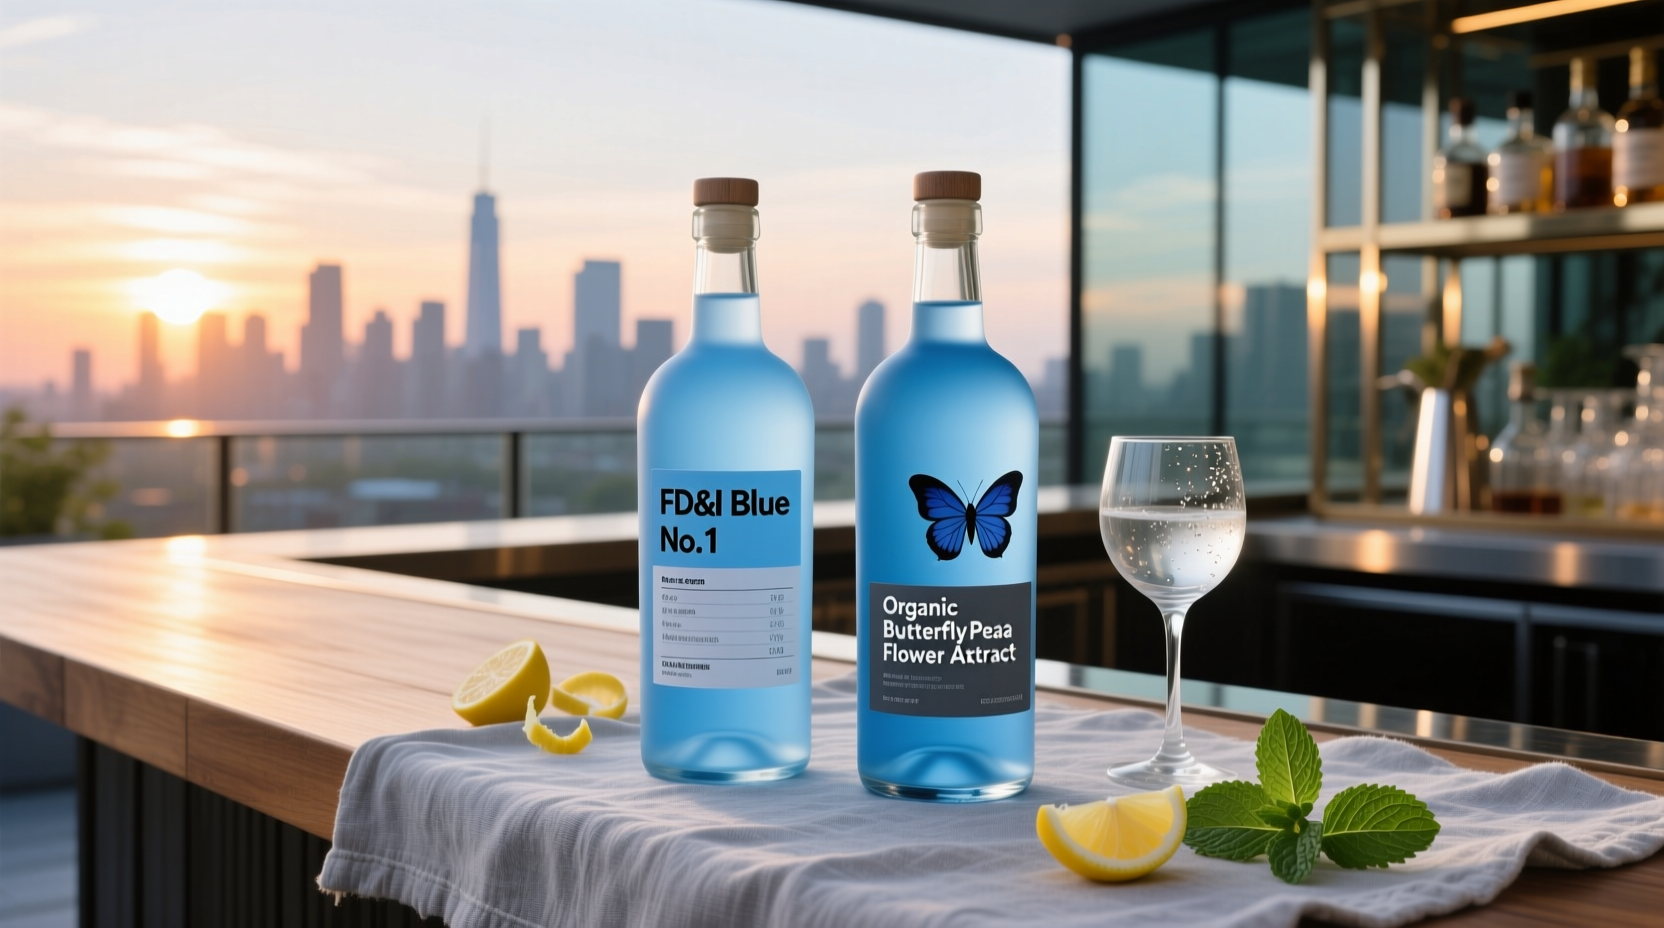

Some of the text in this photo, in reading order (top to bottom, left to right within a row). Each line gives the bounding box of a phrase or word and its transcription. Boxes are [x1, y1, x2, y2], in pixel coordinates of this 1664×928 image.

[731, 488, 790, 517] Blue
[660, 525, 717, 554] No.1
[883, 595, 959, 621] Organic
[883, 619, 1013, 644] Butterfly Peaa
[883, 642, 945, 664] Flower
